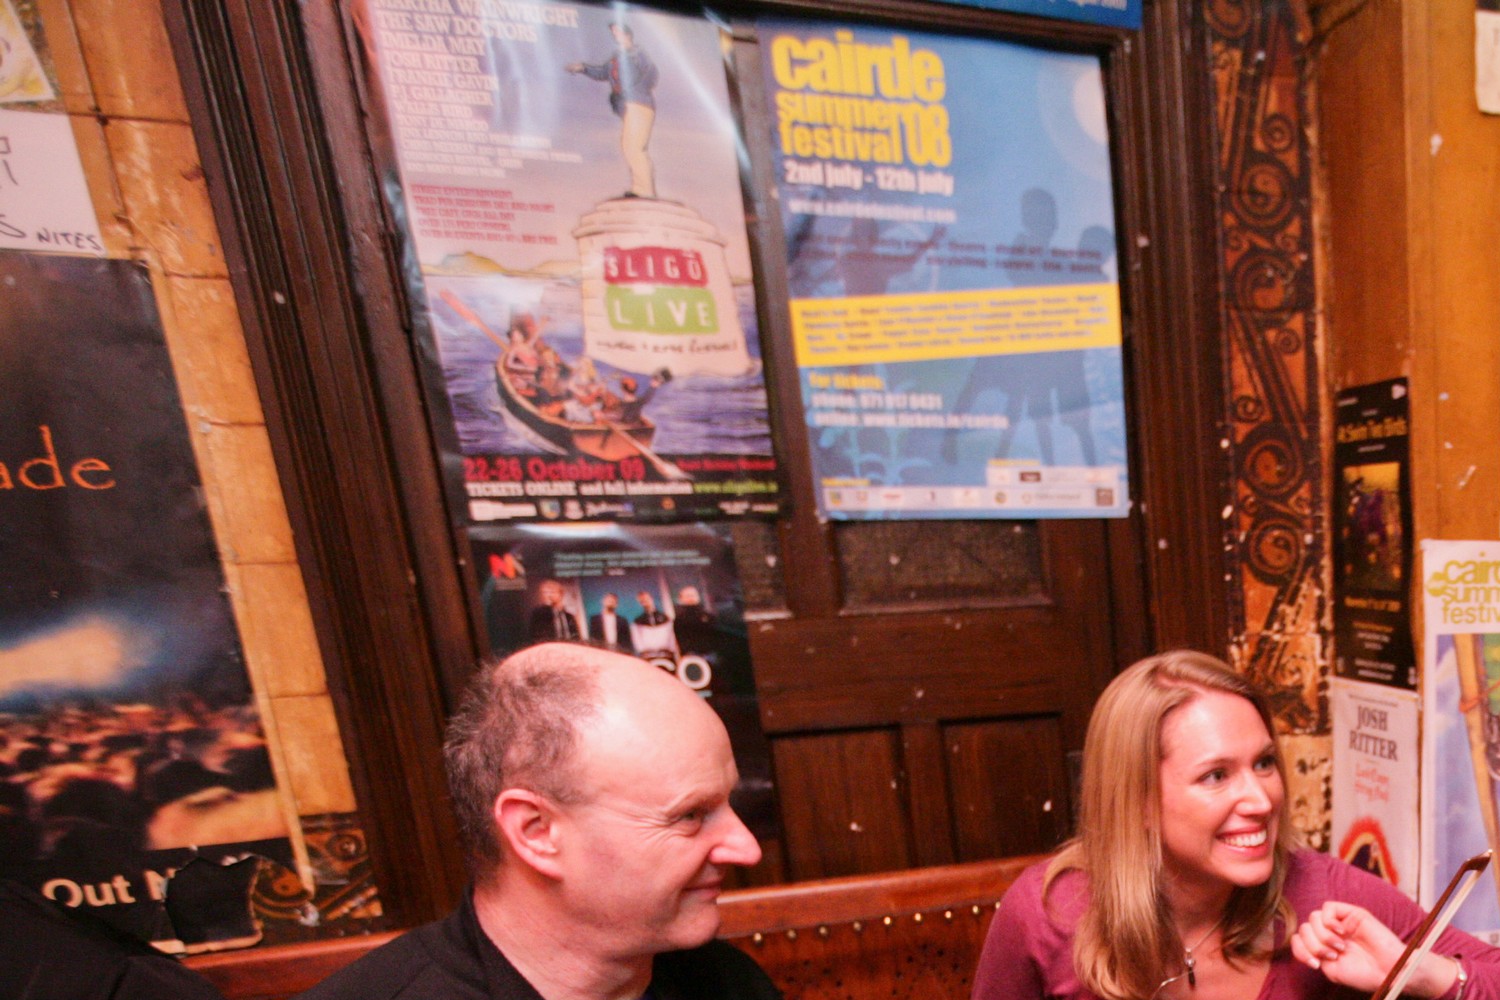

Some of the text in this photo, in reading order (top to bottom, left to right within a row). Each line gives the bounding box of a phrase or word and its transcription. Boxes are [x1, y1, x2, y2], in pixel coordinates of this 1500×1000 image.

[379, 11, 538, 42] THE SAW DOCTORS
[382, 31, 486, 56] IMELDA MAY
[423, 54, 481, 73] RITTER
[771, 29, 946, 102] cairde
[456, 74, 499, 91] GAVIN
[776, 91, 900, 131] summer
[779, 122, 903, 166] festival
[784, 159, 824, 186] 2nd
[825, 161, 864, 191] july
[875, 165, 916, 192] 12th
[917, 169, 954, 197] july
[36, 227, 103, 251] NITES
[606, 253, 703, 281] SLIGO
[614, 299, 713, 328] LIVE
[527, 457, 617, 482] October
[465, 482, 524, 496] TICKETS
[525, 481, 578, 496] ONLINE
[626, 480, 694, 496] information
[1356, 705, 1389, 731] JOSH
[1349, 730, 1398, 761] RITTER
[43, 871, 136, 909] Out
